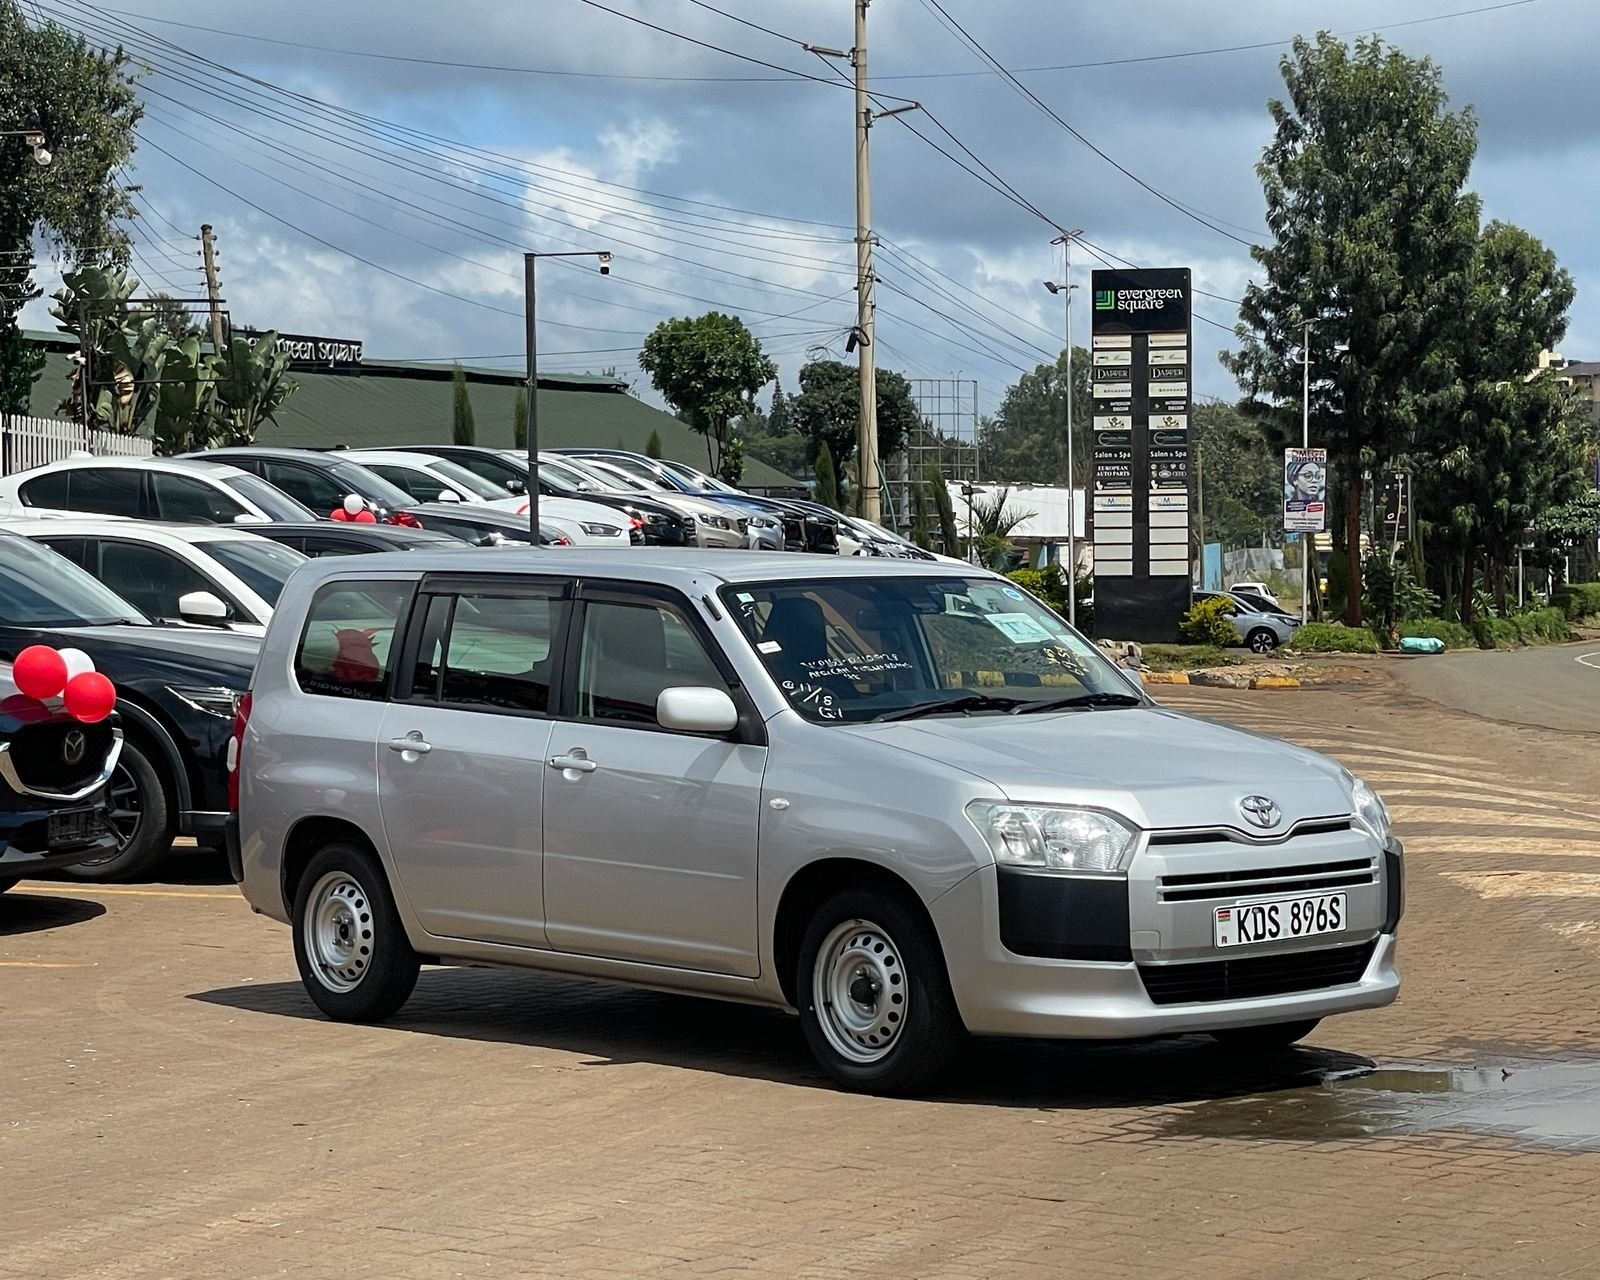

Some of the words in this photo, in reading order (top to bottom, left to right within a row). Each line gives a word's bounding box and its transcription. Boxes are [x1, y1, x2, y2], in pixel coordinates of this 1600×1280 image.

[1117, 288, 1184, 301] evergreen
[1117, 299, 1165, 314] square
[318, 340, 363, 368] square
[1119, 451, 1131, 459] Spa
[1175, 450, 1187, 459] Spa
[1236, 905, 1281, 943] KDS
[1290, 896, 1341, 936] 896S
